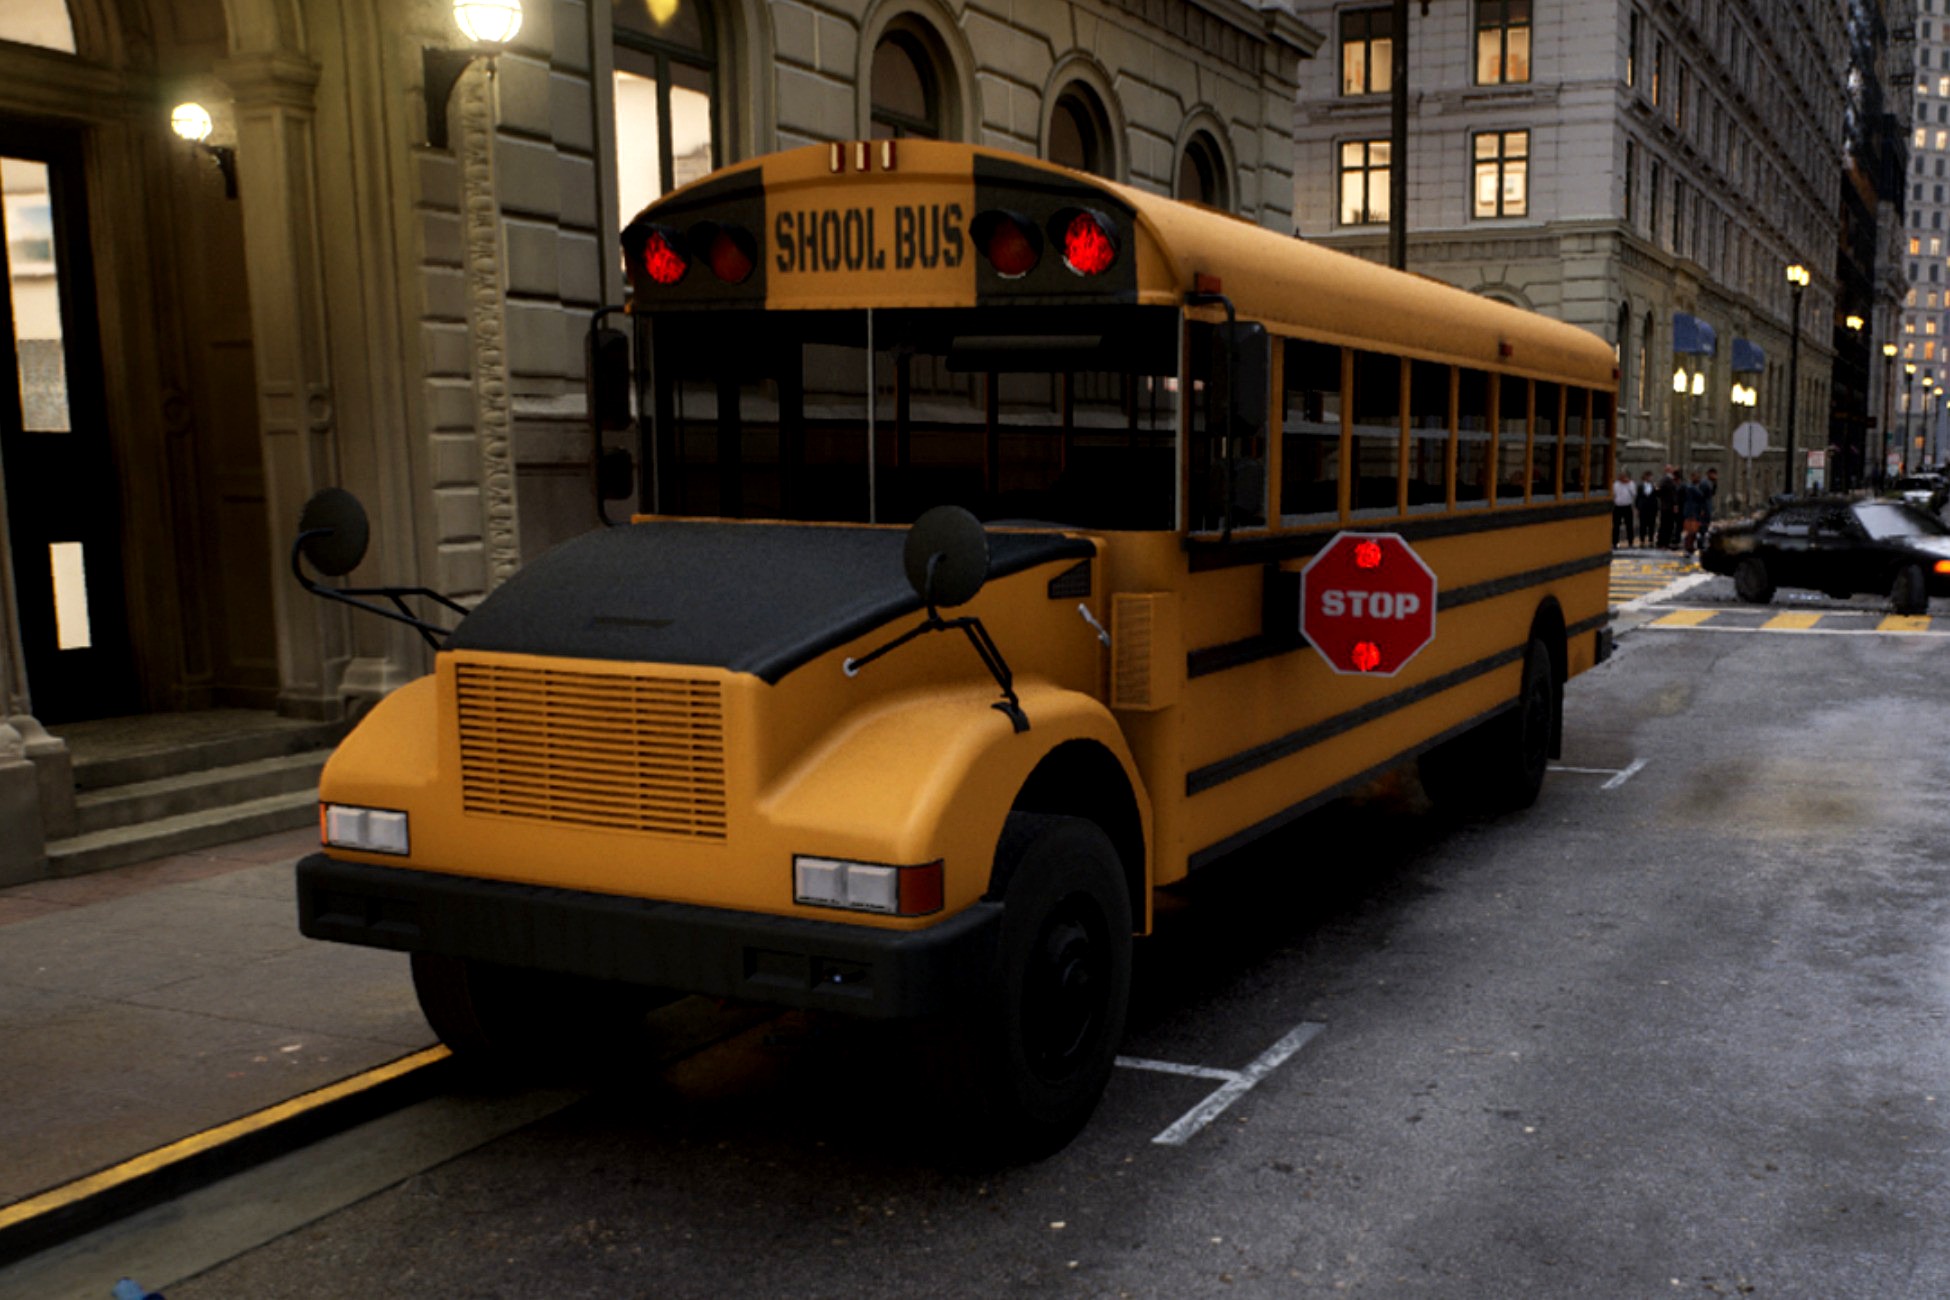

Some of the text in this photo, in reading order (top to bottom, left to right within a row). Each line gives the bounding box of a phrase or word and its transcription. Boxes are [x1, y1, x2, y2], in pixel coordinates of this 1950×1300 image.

[776, 203, 964, 272] SHOOL BUS
[1321, 590, 1420, 619] STOP
